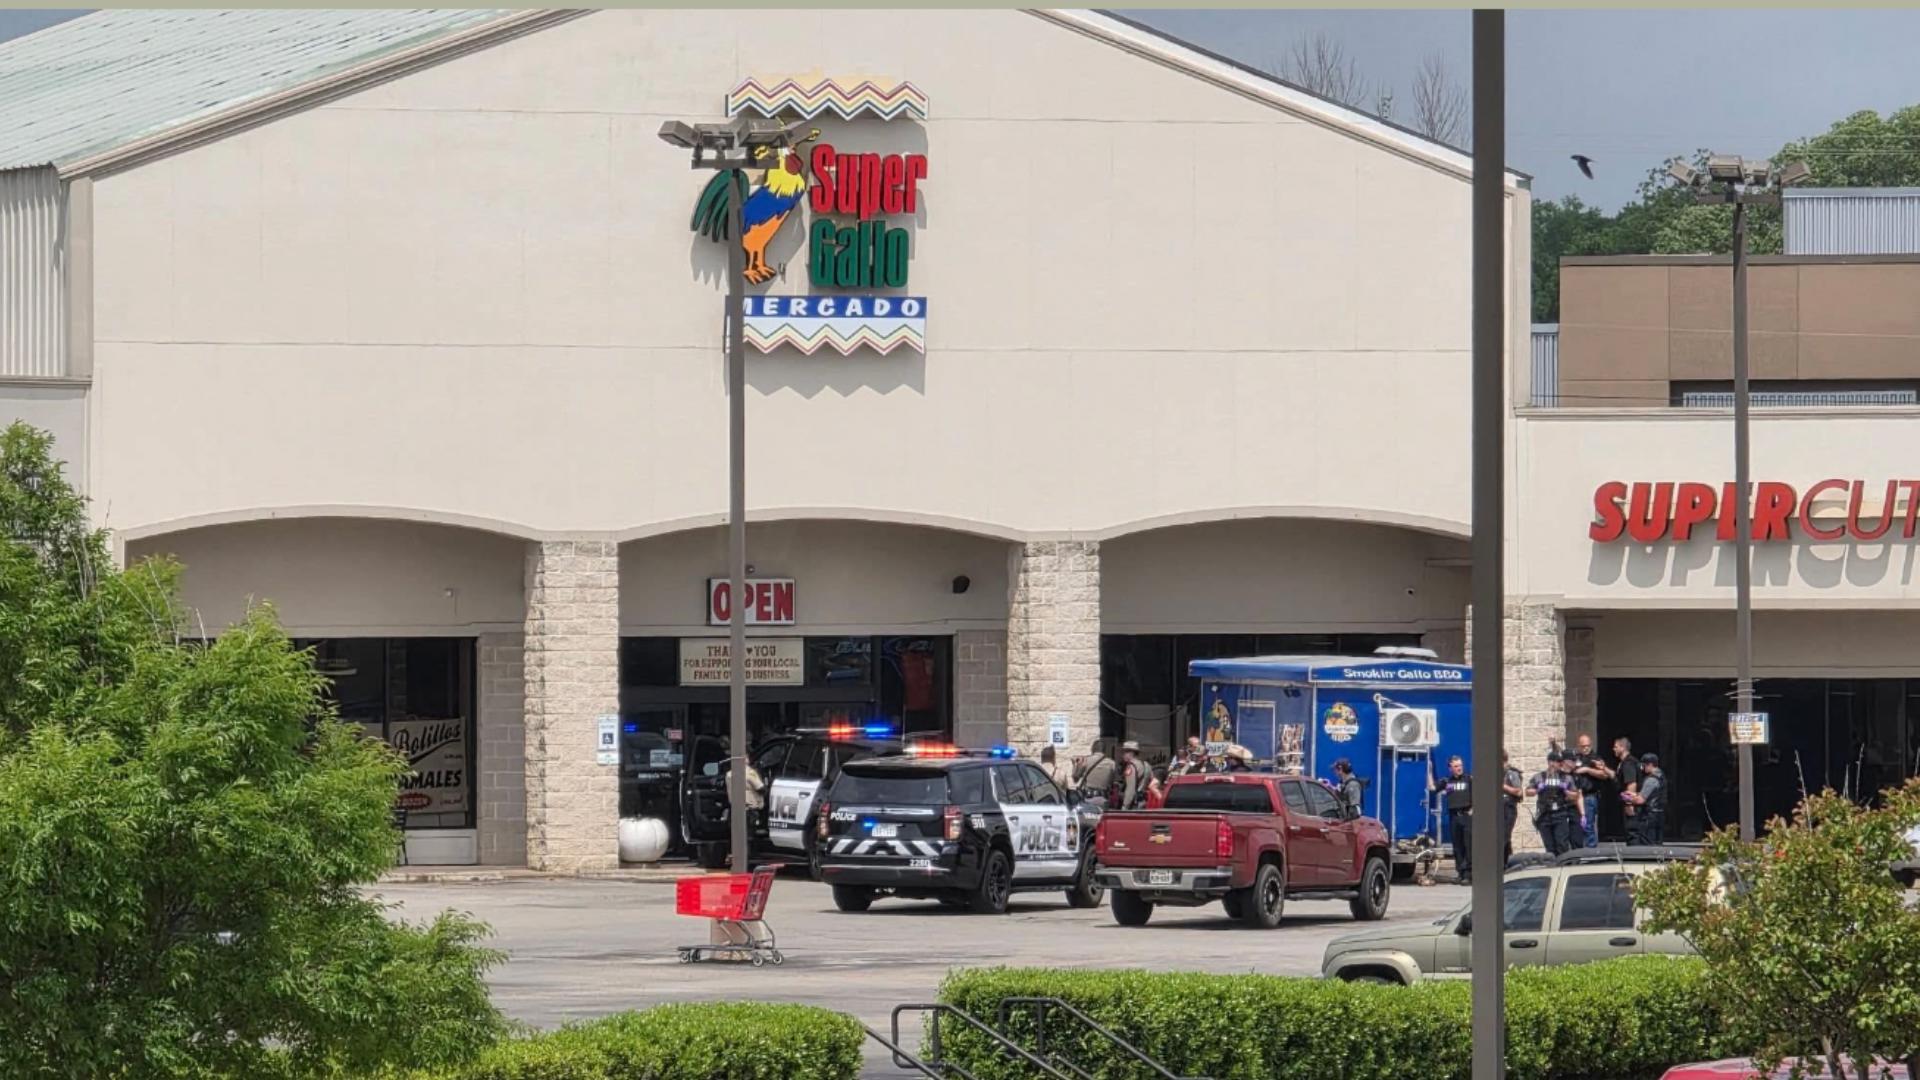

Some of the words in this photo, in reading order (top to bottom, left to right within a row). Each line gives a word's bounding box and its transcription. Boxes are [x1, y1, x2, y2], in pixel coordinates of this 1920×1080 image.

[810, 144, 927, 220] Super
[810, 218, 909, 287] Gallo
[706, 646, 731, 657] THA
[754, 646, 776, 657] YOU
[1434, 670, 1462, 679] BBQ
[391, 770, 461, 789] AMALES
[830, 812, 857, 821] POLICE
[1019, 824, 1061, 851] POLICE
